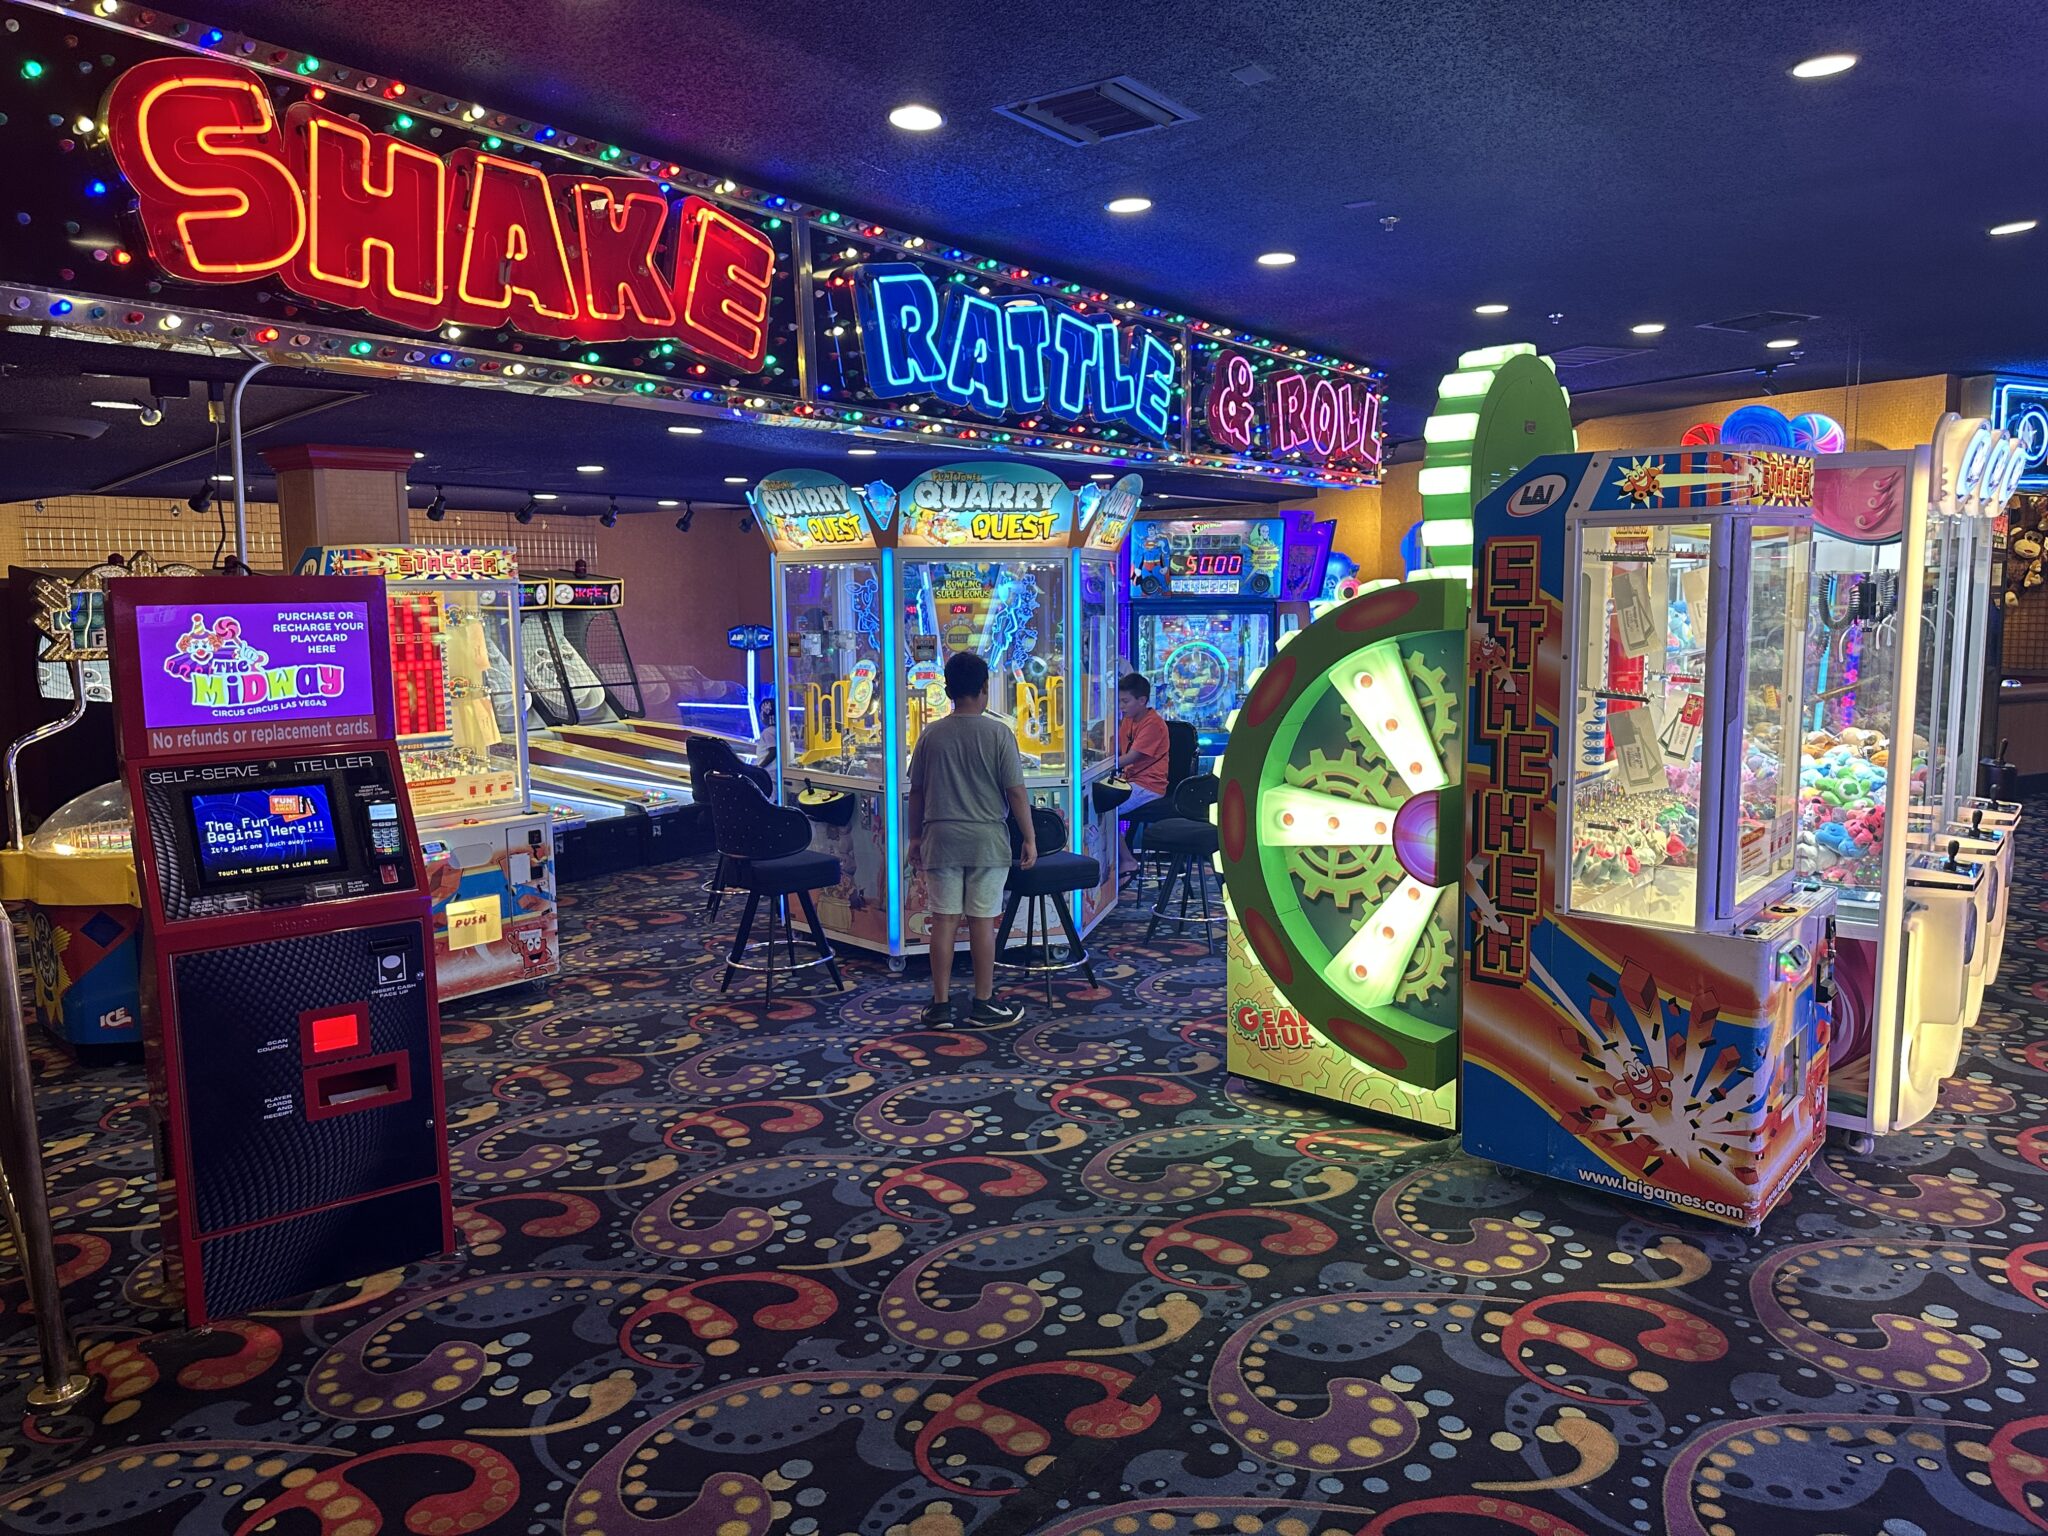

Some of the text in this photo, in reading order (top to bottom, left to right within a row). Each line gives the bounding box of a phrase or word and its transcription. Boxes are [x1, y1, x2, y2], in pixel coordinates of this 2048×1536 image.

[107, 57, 1383, 466] SHAKE RATTLE & ROLL
[1762, 456, 1811, 501] STACKER
[762, 484, 851, 516] QUARRY
[913, 480, 1063, 512] QUARRY
[1519, 484, 1555, 506] LAI
[807, 513, 863, 543] QUEST
[971, 513, 1060, 541] QUEST
[398, 551, 500, 575] STACKER
[1186, 556, 1242, 575] 5000
[945, 580, 982, 589] BOWLING
[936, 590, 990, 599] SUPER BONUS
[278, 611, 354, 621] PURCHASE OR
[273, 622, 364, 632] RECHARGE YOUR
[290, 633, 348, 643] PLAYCARD
[308, 645, 336, 654] HERE
[212, 699, 327, 717] CIRCUS CIRCUS LAS VEGAS
[153, 718, 373, 750] No refunds or replacement cards.
[1482, 538, 1551, 976] STACKER
[149, 756, 374, 785] SELF-SERVE iTELLER
[205, 817, 270, 832] The Fun
[207, 820, 324, 844] Begins Here!!!
[211, 846, 228, 854] It's
[231, 844, 248, 853] just
[265, 840, 286, 848] touch
[256, 865, 279, 873] SCREEN
[455, 913, 487, 928] PUSH
[100, 1007, 126, 1028] ICE
[257, 1043, 288, 1053] COUPON
[267, 1038, 288, 1046] SCAN
[264, 1094, 292, 1103] PLAYER
[266, 1100, 293, 1109] CARDS
[264, 1109, 294, 1120] RECEIPT
[277, 1104, 293, 1112] AND
[1578, 1167, 1744, 1220] www.laigames.com
